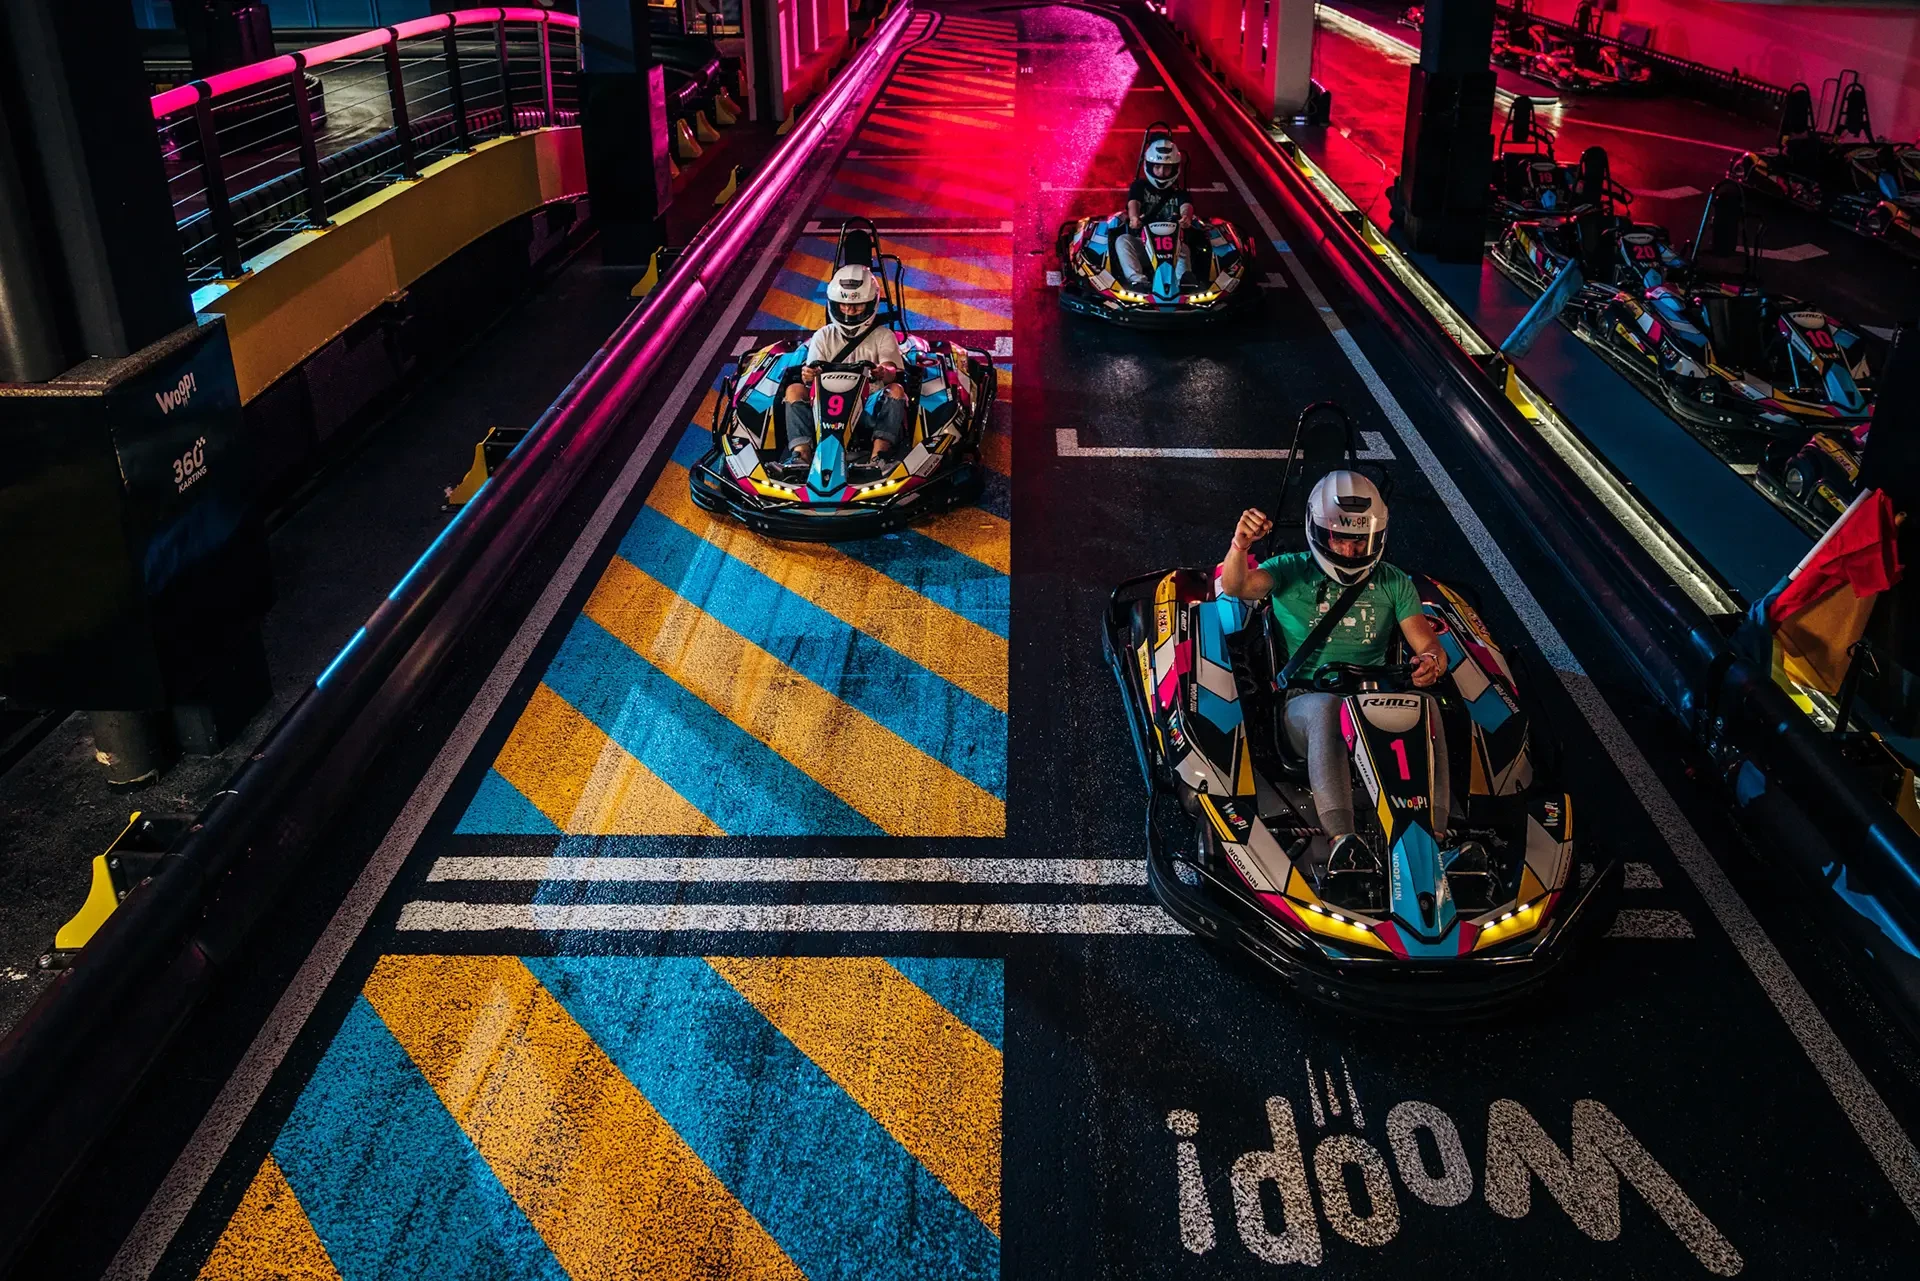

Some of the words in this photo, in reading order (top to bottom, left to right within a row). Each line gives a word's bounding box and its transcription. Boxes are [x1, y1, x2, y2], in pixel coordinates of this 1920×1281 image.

[1154, 236, 1173, 251] 16
[1633, 245, 1655, 259] 20
[1805, 330, 1834, 348] 10
[827, 395, 844, 416] 9
[173, 436, 206, 484] 360
[178, 465, 207, 494] KARTING
[1390, 739, 1411, 780] 1
[1228, 846, 1259, 888] WOOP.FUN
[1392, 852, 1402, 901] WOOP.FUN
